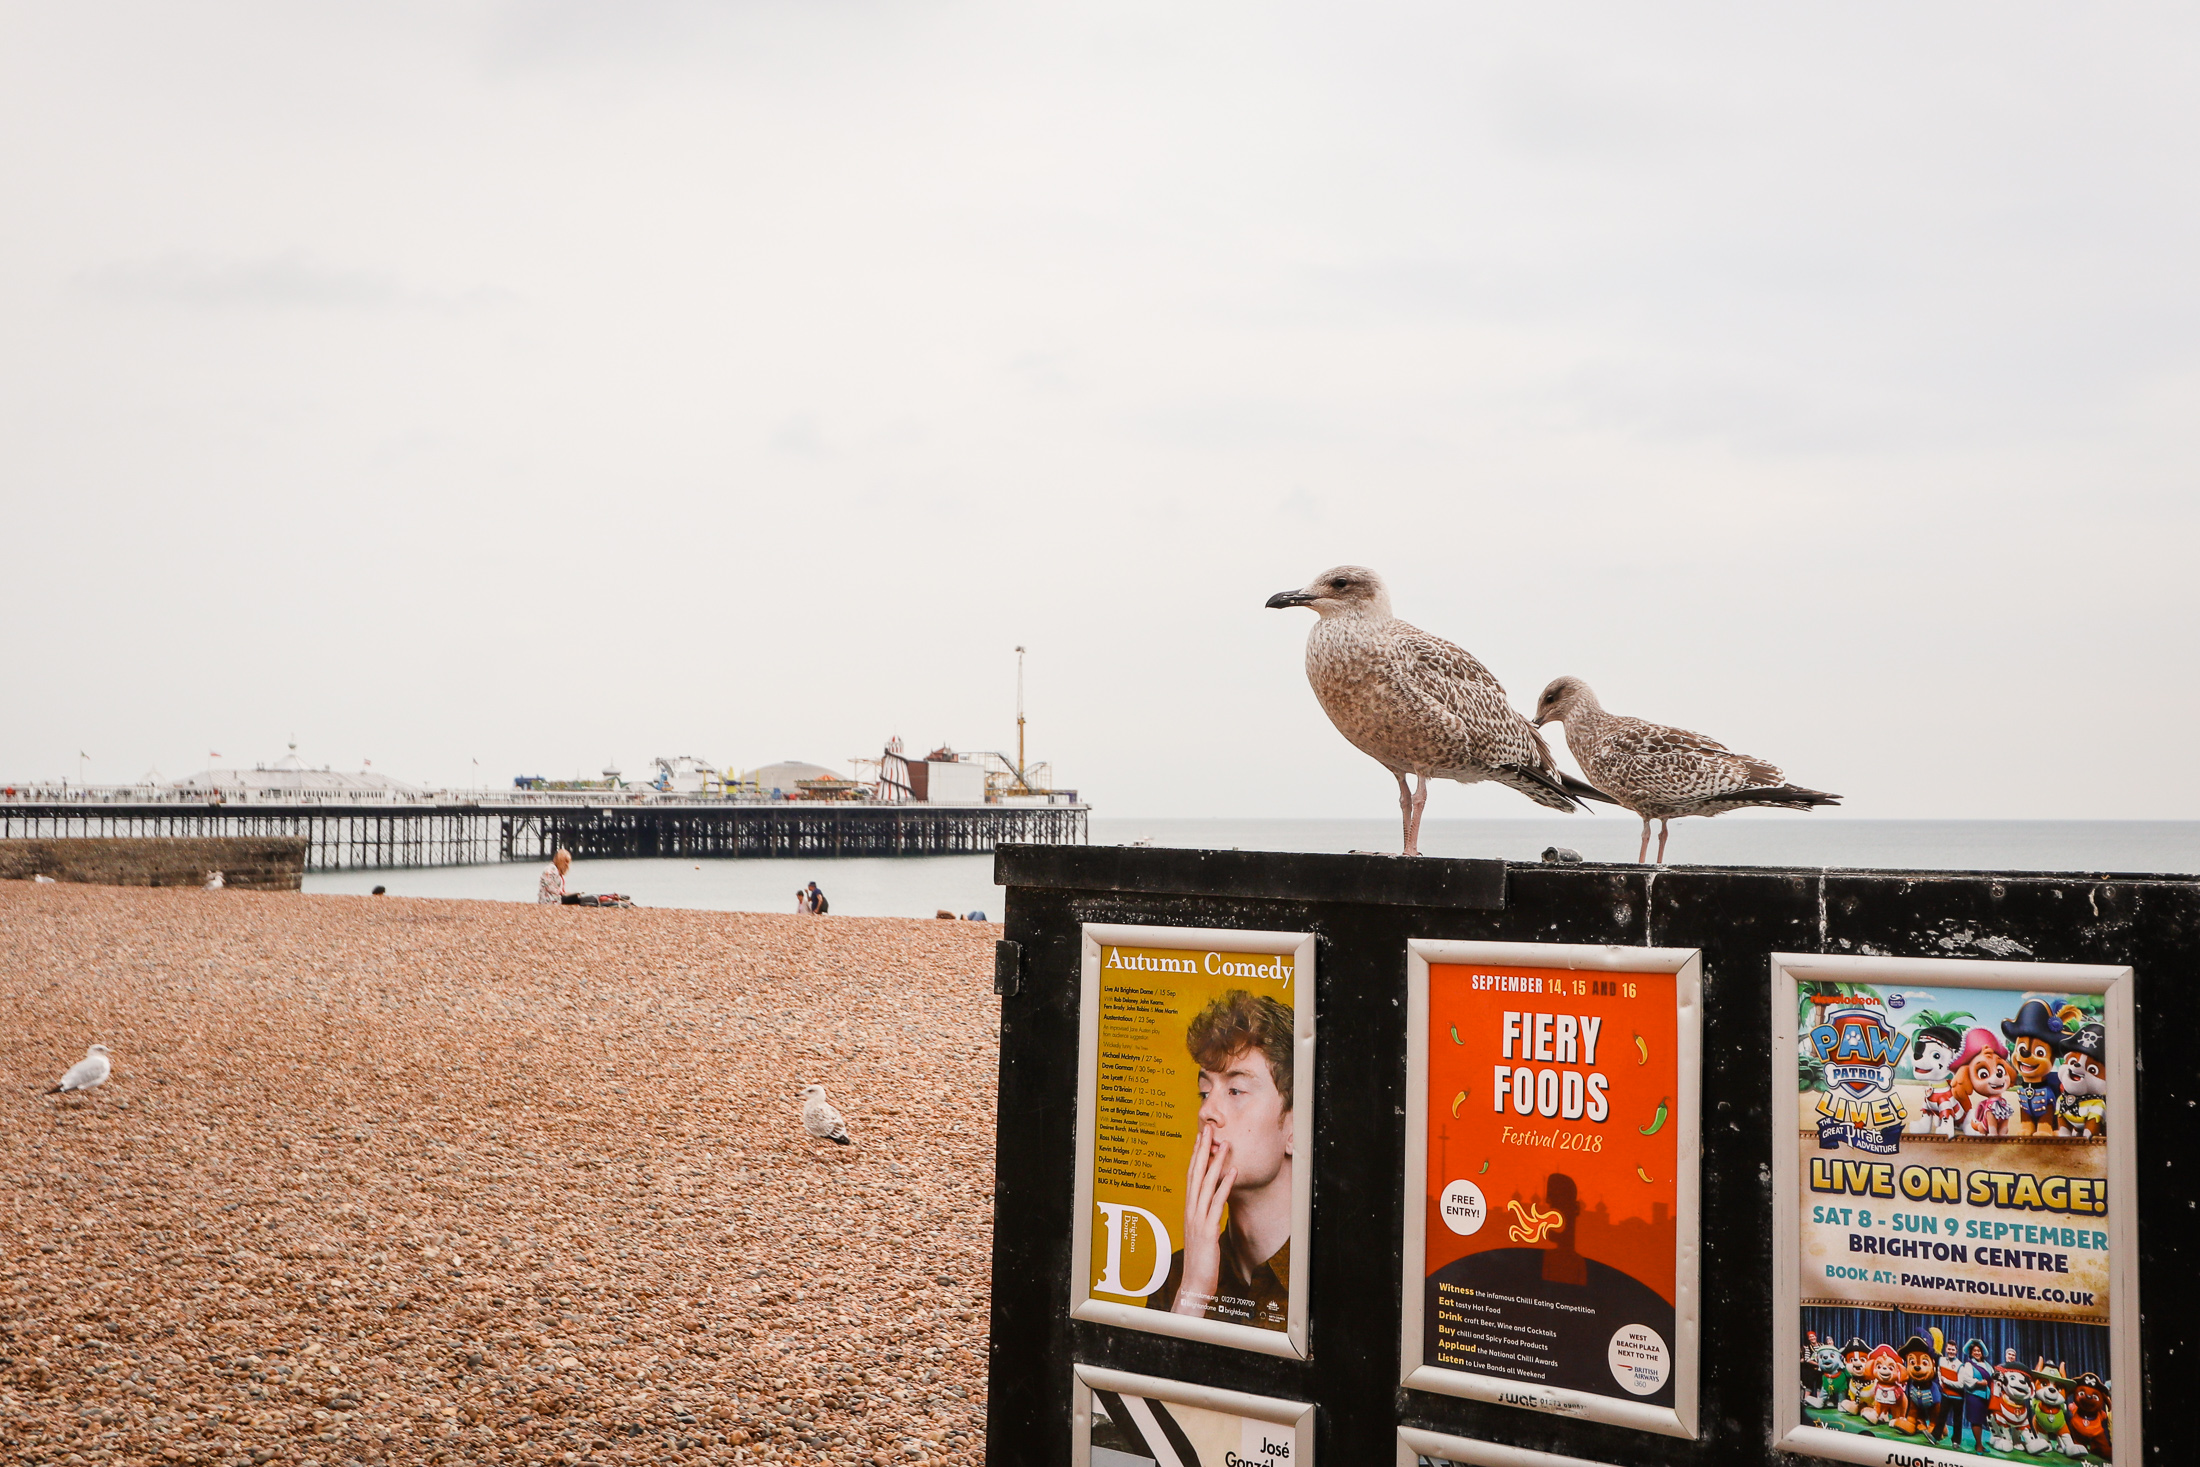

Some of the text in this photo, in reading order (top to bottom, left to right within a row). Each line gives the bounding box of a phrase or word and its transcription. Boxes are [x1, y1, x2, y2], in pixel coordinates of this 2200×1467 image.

[1105, 947, 1294, 989] Autumn Comedy
[1120, 987, 1139, 995] Brighton
[1472, 974, 1637, 998] SEPTEMBER 14, 15 AND 16
[1146, 1017, 1155, 1025] Sep
[1502, 1011, 1602, 1065] FIERY
[1808, 1023, 1910, 1066] PAW
[1121, 1053, 1140, 1062] McIntyre
[1833, 1068, 1884, 1082] PATROL
[1116, 1096, 1133, 1104] Millican
[1493, 1065, 1610, 1123] FOODS
[1136, 1109, 1150, 1117] Dome
[1815, 1090, 1908, 1126] LIVE!
[1819, 1117, 1831, 1127] THE
[1502, 1126, 1603, 1153] Festival 2018
[1822, 1122, 1883, 1149] GREAT Pirate
[1113, 1146, 1130, 1155] Bridges
[1156, 1151, 1166, 1159] Nov
[1856, 1141, 1897, 1153] ADVENTURE
[1113, 1157, 1129, 1165] Moran
[1142, 1160, 1152, 1168] Nov
[1113, 1169, 1137, 1178] O'Doherty
[1114, 1179, 1120, 1187] by
[1121, 1180, 1134, 1188] Adam
[1810, 1157, 2108, 1217] LIVE ON STAGE!
[1451, 1194, 1475, 1206] FREE
[1446, 1206, 1480, 1218] ENTRY!
[1129, 1216, 1139, 1253] Brighton
[1813, 1205, 1853, 1227] SAT
[1858, 1210, 1871, 1228] 8
[1892, 1213, 1937, 1235] SUN
[1944, 1218, 1960, 1237] 9
[1966, 1220, 2109, 1251] SEPTEMBER
[1093, 1201, 1172, 1298] D
[1849, 1233, 2069, 1273] BRIGHTON CENTRE
[1826, 1265, 2094, 1307] BOOK AT: PAWPATROLLIVE.CO.UK
[1221, 1295, 1235, 1304] 01273
[1237, 1298, 1255, 1307] 709709
[1439, 1282, 1474, 1296] Witness
[1487, 1292, 1515, 1302] infamous
[1516, 1296, 1532, 1305] Chilli
[1534, 1299, 1554, 1309] Eating
[1556, 1303, 1596, 1314] Competition
[1439, 1296, 1501, 1314] Eat tasty Hot Food
[1225, 1307, 1250, 1318] brightdome
[1439, 1311, 1557, 1337] Drink craft Beer, Wine and Cocktails
[1438, 1325, 1548, 1351] Buy chilli and Spicy Food Products
[1629, 1333, 1647, 1341] WEST
[1438, 1339, 1558, 1367] Applaud the National Chilli Awards
[1617, 1340, 1660, 1352] BEACH PLAZA
[1618, 1349, 1634, 1357] NEXT
[1438, 1352, 1464, 1365] Listen
[1473, 1361, 1485, 1369] Live
[1487, 1363, 1506, 1373] Bands
[1517, 1369, 1546, 1380] Weekend
[1634, 1367, 1658, 1375] BRITISH
[1634, 1373, 1659, 1382] AIRWAYS
[1260, 1437, 1290, 1458] José
[1885, 1453, 1935, 1467] swat
